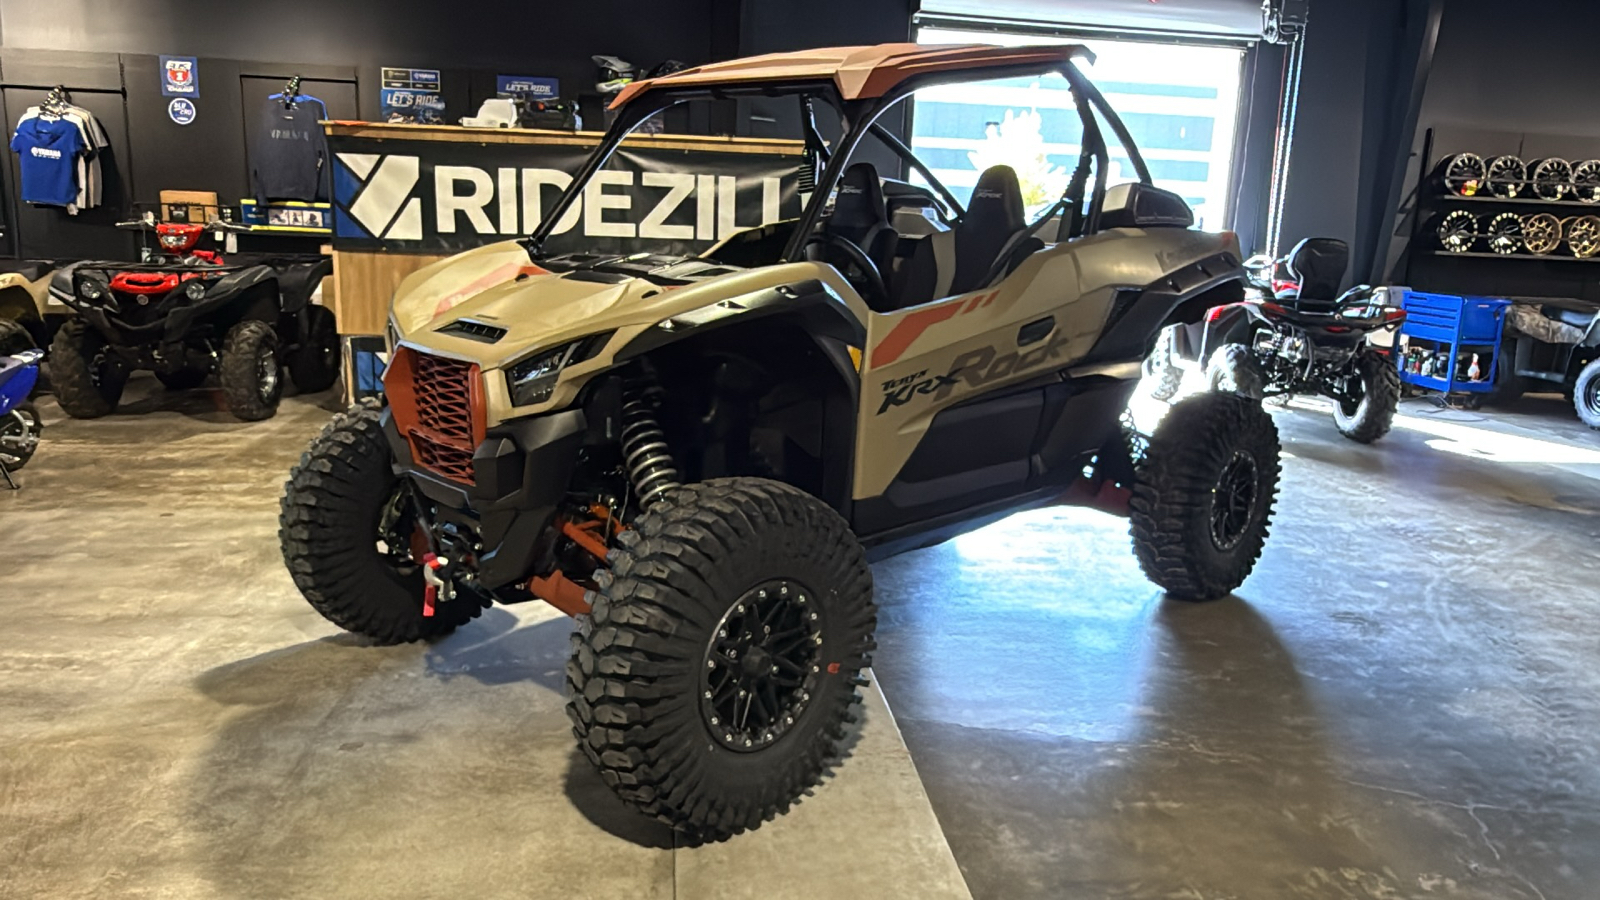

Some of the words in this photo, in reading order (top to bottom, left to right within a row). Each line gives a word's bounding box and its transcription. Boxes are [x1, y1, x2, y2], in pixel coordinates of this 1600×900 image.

[386, 92, 414, 107] LET'S
[415, 94, 439, 106] RIDE
[434, 165, 812, 241] RIDEZILL
